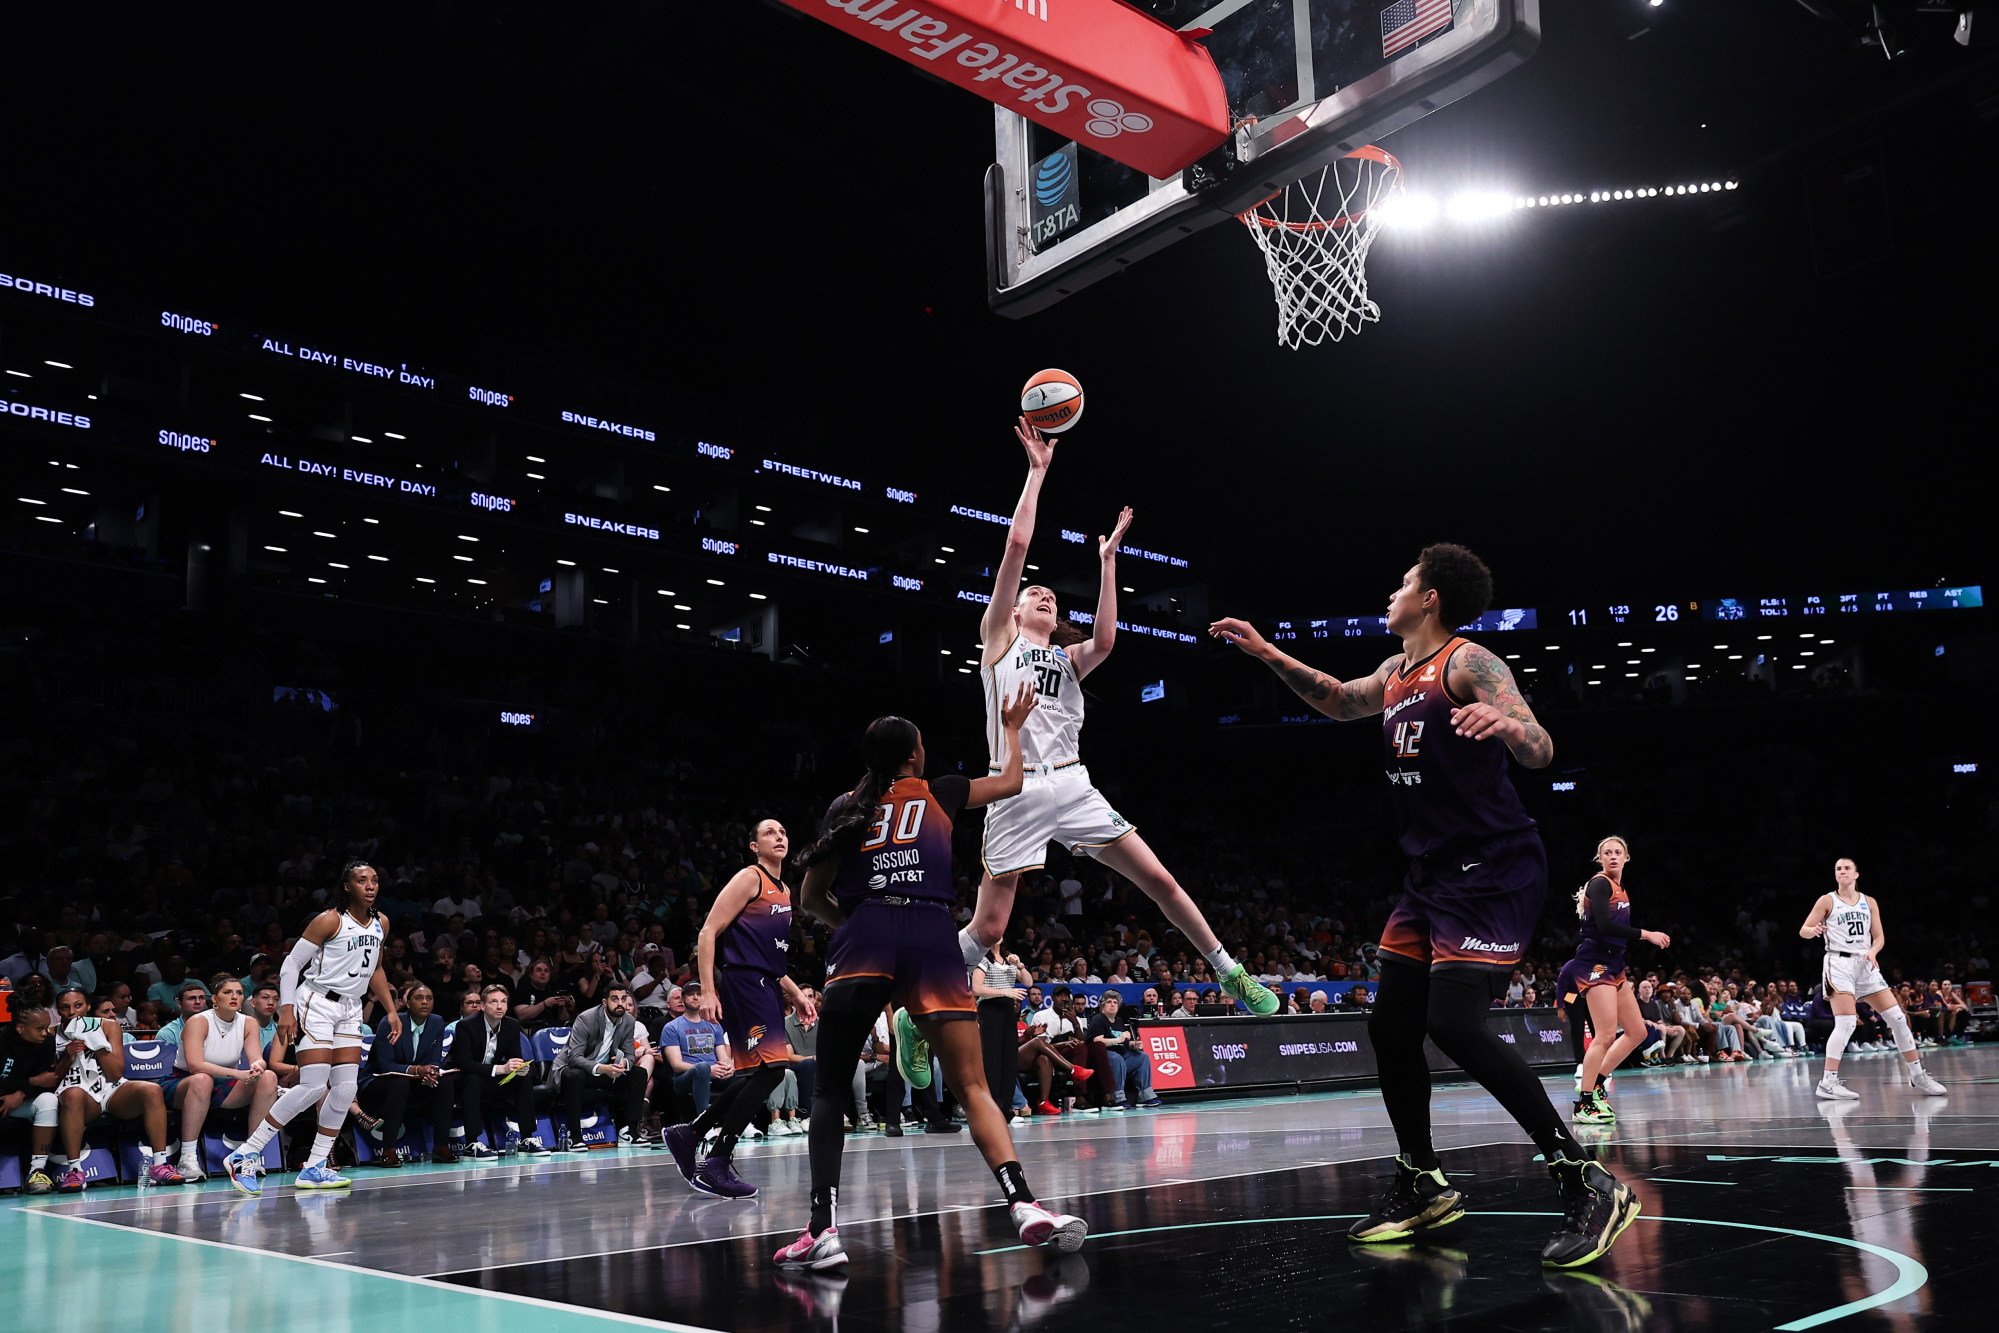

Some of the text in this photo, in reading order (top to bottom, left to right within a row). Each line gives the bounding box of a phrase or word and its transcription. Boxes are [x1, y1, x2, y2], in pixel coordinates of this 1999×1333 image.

[161, 311, 212, 336] snipes
[263, 339, 435, 389] ALL DAY! EVERY DAY!
[469, 386, 509, 407] snipes
[561, 411, 656, 442] SNEAKERS
[158, 429, 210, 452] snipes
[697, 442, 731, 460] snipes
[261, 453, 436, 496] ALL DAY! EVERY DAY!
[763, 459, 861, 491] STREETWEAR
[470, 492, 511, 512] snipes
[886, 486, 914, 503] snipes
[565, 513, 660, 540] SNEAKERS
[1061, 529, 1085, 544] snipes
[702, 537, 735, 555] snipes
[1123, 545, 1142, 557] DAY!
[1144, 550, 1169, 563] EVERY
[1170, 556, 1188, 568] DAY!
[768, 552, 868, 580] STREETWEAR
[893, 575, 921, 591] snipes
[1840, 594, 1858, 602] 3PT
[1944, 588, 1963, 597] AST
[1069, 610, 1093, 625] snipes
[1568, 609, 1587, 626] 11
[1608, 605, 1630, 615] 1:23
[1654, 605, 1679, 622] 26
[1311, 620, 1328, 628] 3PT
[1347, 618, 1360, 626] FT
[1131, 623, 1150, 635] DAY!
[1152, 627, 1178, 640] EVERY
[1179, 633, 1197, 644] DAY!
[1034, 665, 1061, 699] 30
[501, 711, 531, 726] snipes
[1393, 720, 1425, 757] 42
[862, 799, 927, 852] 30
[872, 848, 920, 871] SISSOKO
[890, 870, 924, 884] AT&T
[1847, 921, 1864, 936] 20
[361, 948, 372, 968] 5
[1150, 1036, 1178, 1052] BIO
[1212, 1043, 1246, 1062] snipes
[1279, 1041, 1358, 1056] SNIPESUSA.COM
[1153, 1051, 1180, 1060] STEEL
[130, 1062, 163, 1072] Webull
